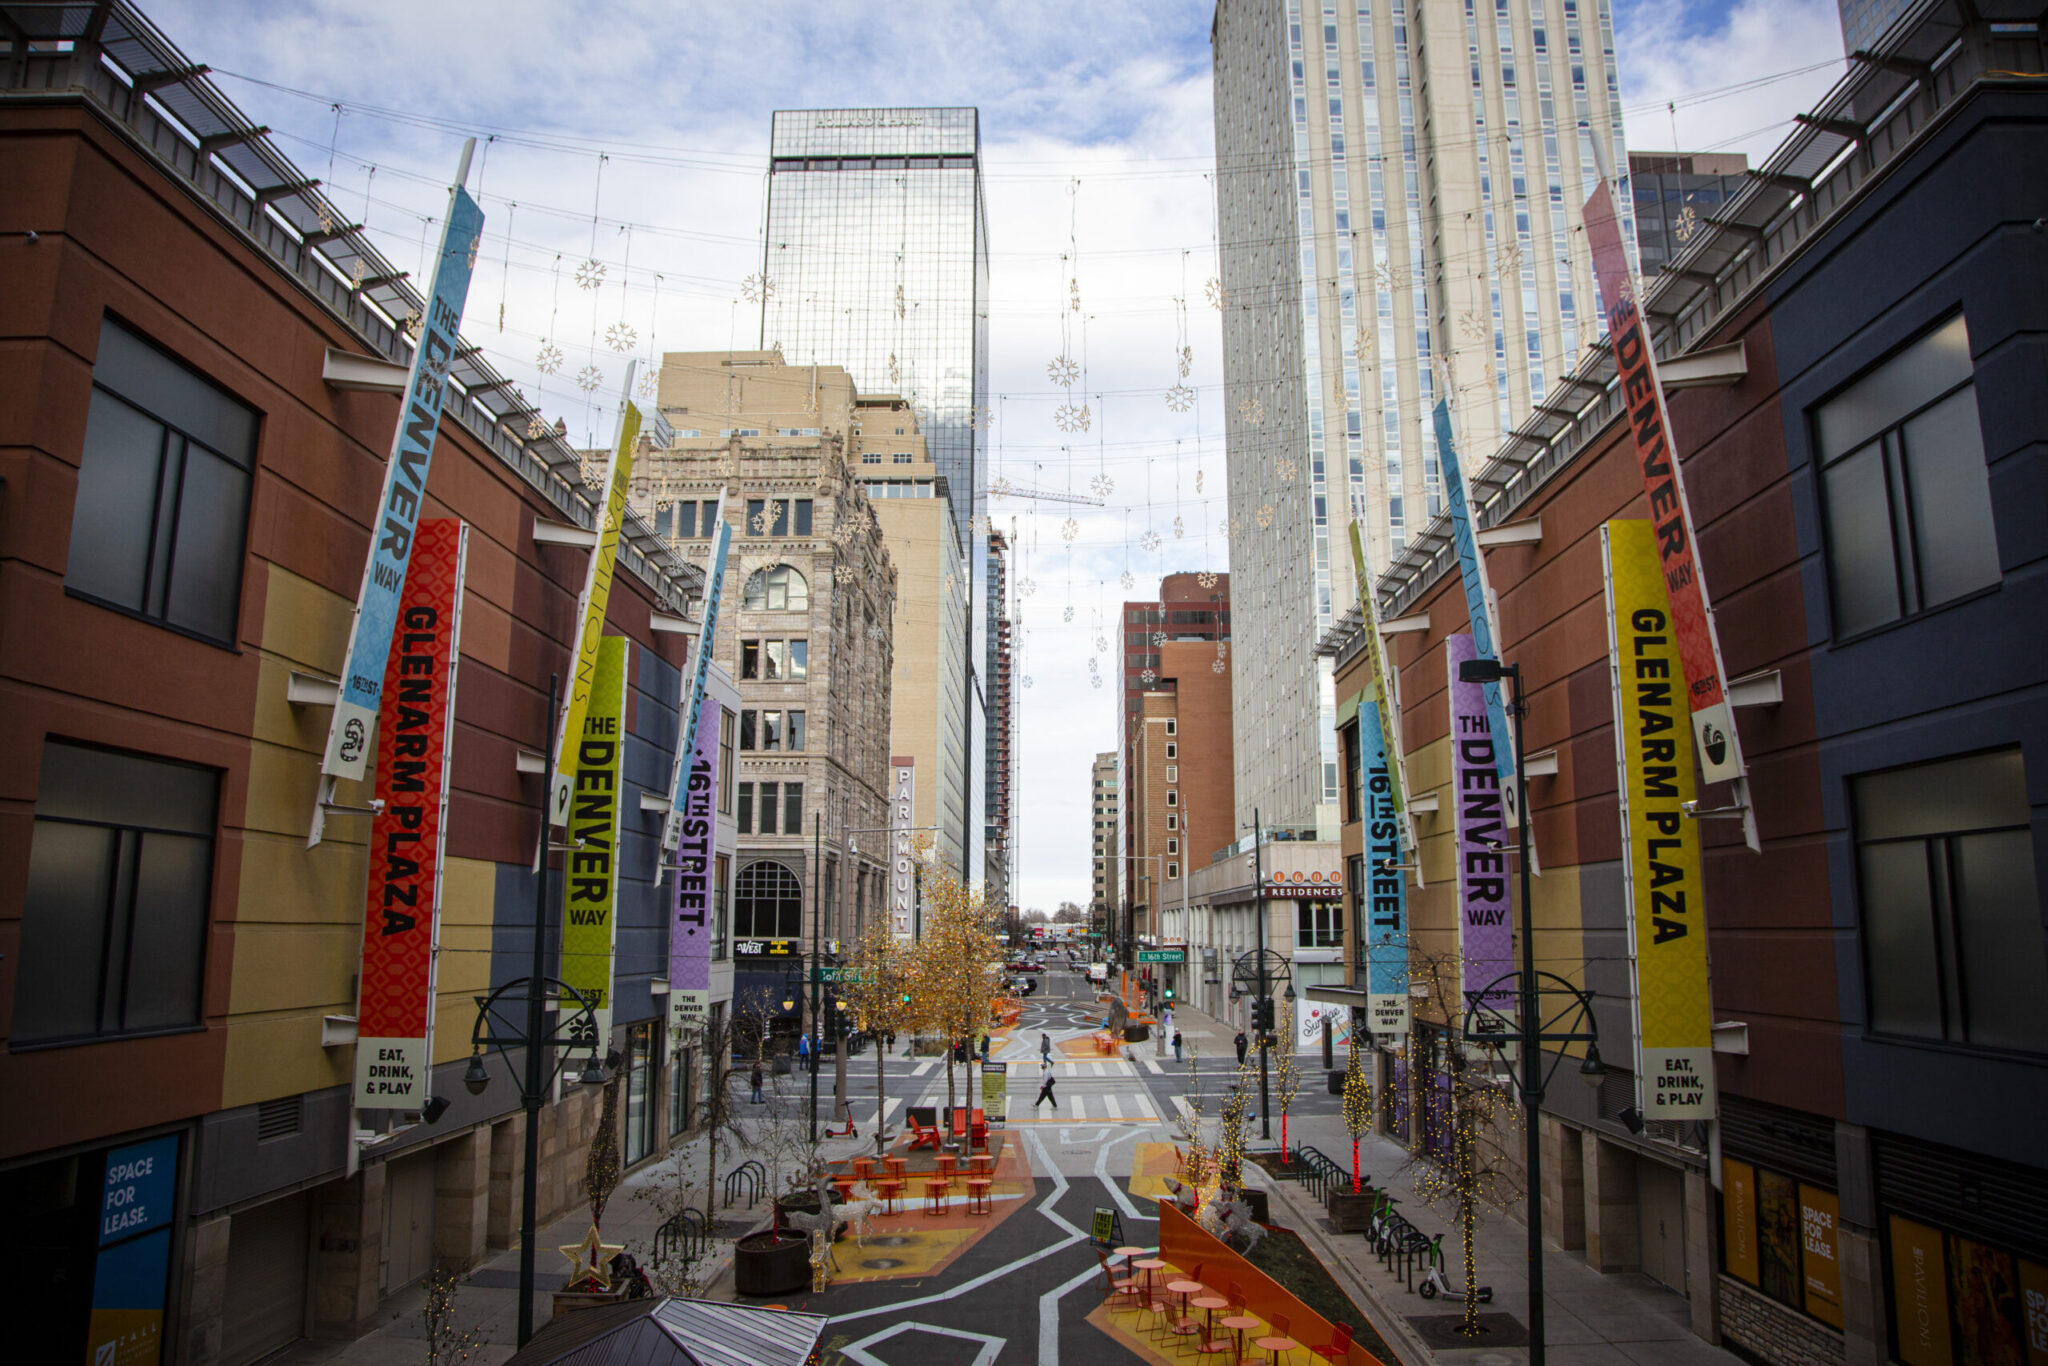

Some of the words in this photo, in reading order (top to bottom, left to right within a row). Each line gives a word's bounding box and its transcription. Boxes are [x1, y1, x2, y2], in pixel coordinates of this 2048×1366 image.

[434, 295, 459, 338] THE
[1608, 301, 1635, 333] THE
[380, 327, 452, 561] DENVER
[1617, 319, 1687, 562] DENVER
[374, 561, 402, 594] WAY
[1666, 560, 1693, 593] WAY
[574, 487, 626, 706] PAVILIONS
[1450, 487, 1502, 706] PAVILIOS
[699, 572, 721, 677] GLENARM
[391, 606, 437, 791] GLENARM
[1632, 608, 1679, 798] GLENARM
[583, 717, 615, 734] THE
[684, 684, 703, 755] PLAZA
[571, 740, 615, 903] DENVER
[1460, 739, 1505, 904] DENVER
[897, 769, 911, 930] PARAMOUNT
[382, 806, 423, 936] PLAZA
[679, 819, 709, 927] STREET
[1274, 872, 1341, 883] 1600
[1371, 821, 1399, 931] STREET
[1646, 811, 1688, 945] PLAZA
[1272, 888, 1343, 896] RESIDENCES
[569, 909, 607, 926] WAY
[1467, 909, 1506, 927] WAY
[1147, 953, 1160, 961] 16th
[1162, 952, 1182, 961] Street
[674, 1004, 703, 1012] DENVER
[682, 995, 696, 1003] THE
[1375, 1009, 1404, 1017] DENVER
[680, 1013, 697, 1021] WAY
[1303, 1008, 1340, 1037] Sunae
[1381, 1018, 1398, 1026] WAY
[379, 1048, 405, 1063] EAT,
[1665, 1058, 1693, 1073] EAT,
[369, 1065, 414, 1081] DRINK,
[1657, 1075, 1704, 1090] DRINK,
[366, 1081, 375, 1095] &
[379, 1082, 412, 1095] PLAY
[1656, 1092, 1666, 1105] &
[1669, 1092, 1703, 1105] PLAY
[108, 1156, 153, 1185] SPACE
[106, 1185, 136, 1211] FOR
[104, 1205, 148, 1235] LEASE.
[1735, 1188, 1748, 1260] PAVILIONS
[1802, 1205, 1833, 1229] SPACE
[1803, 1221, 1823, 1241] FOR
[1804, 1237, 1835, 1261] LEASE.
[1912, 1255, 1932, 1348] PAVILIONS
